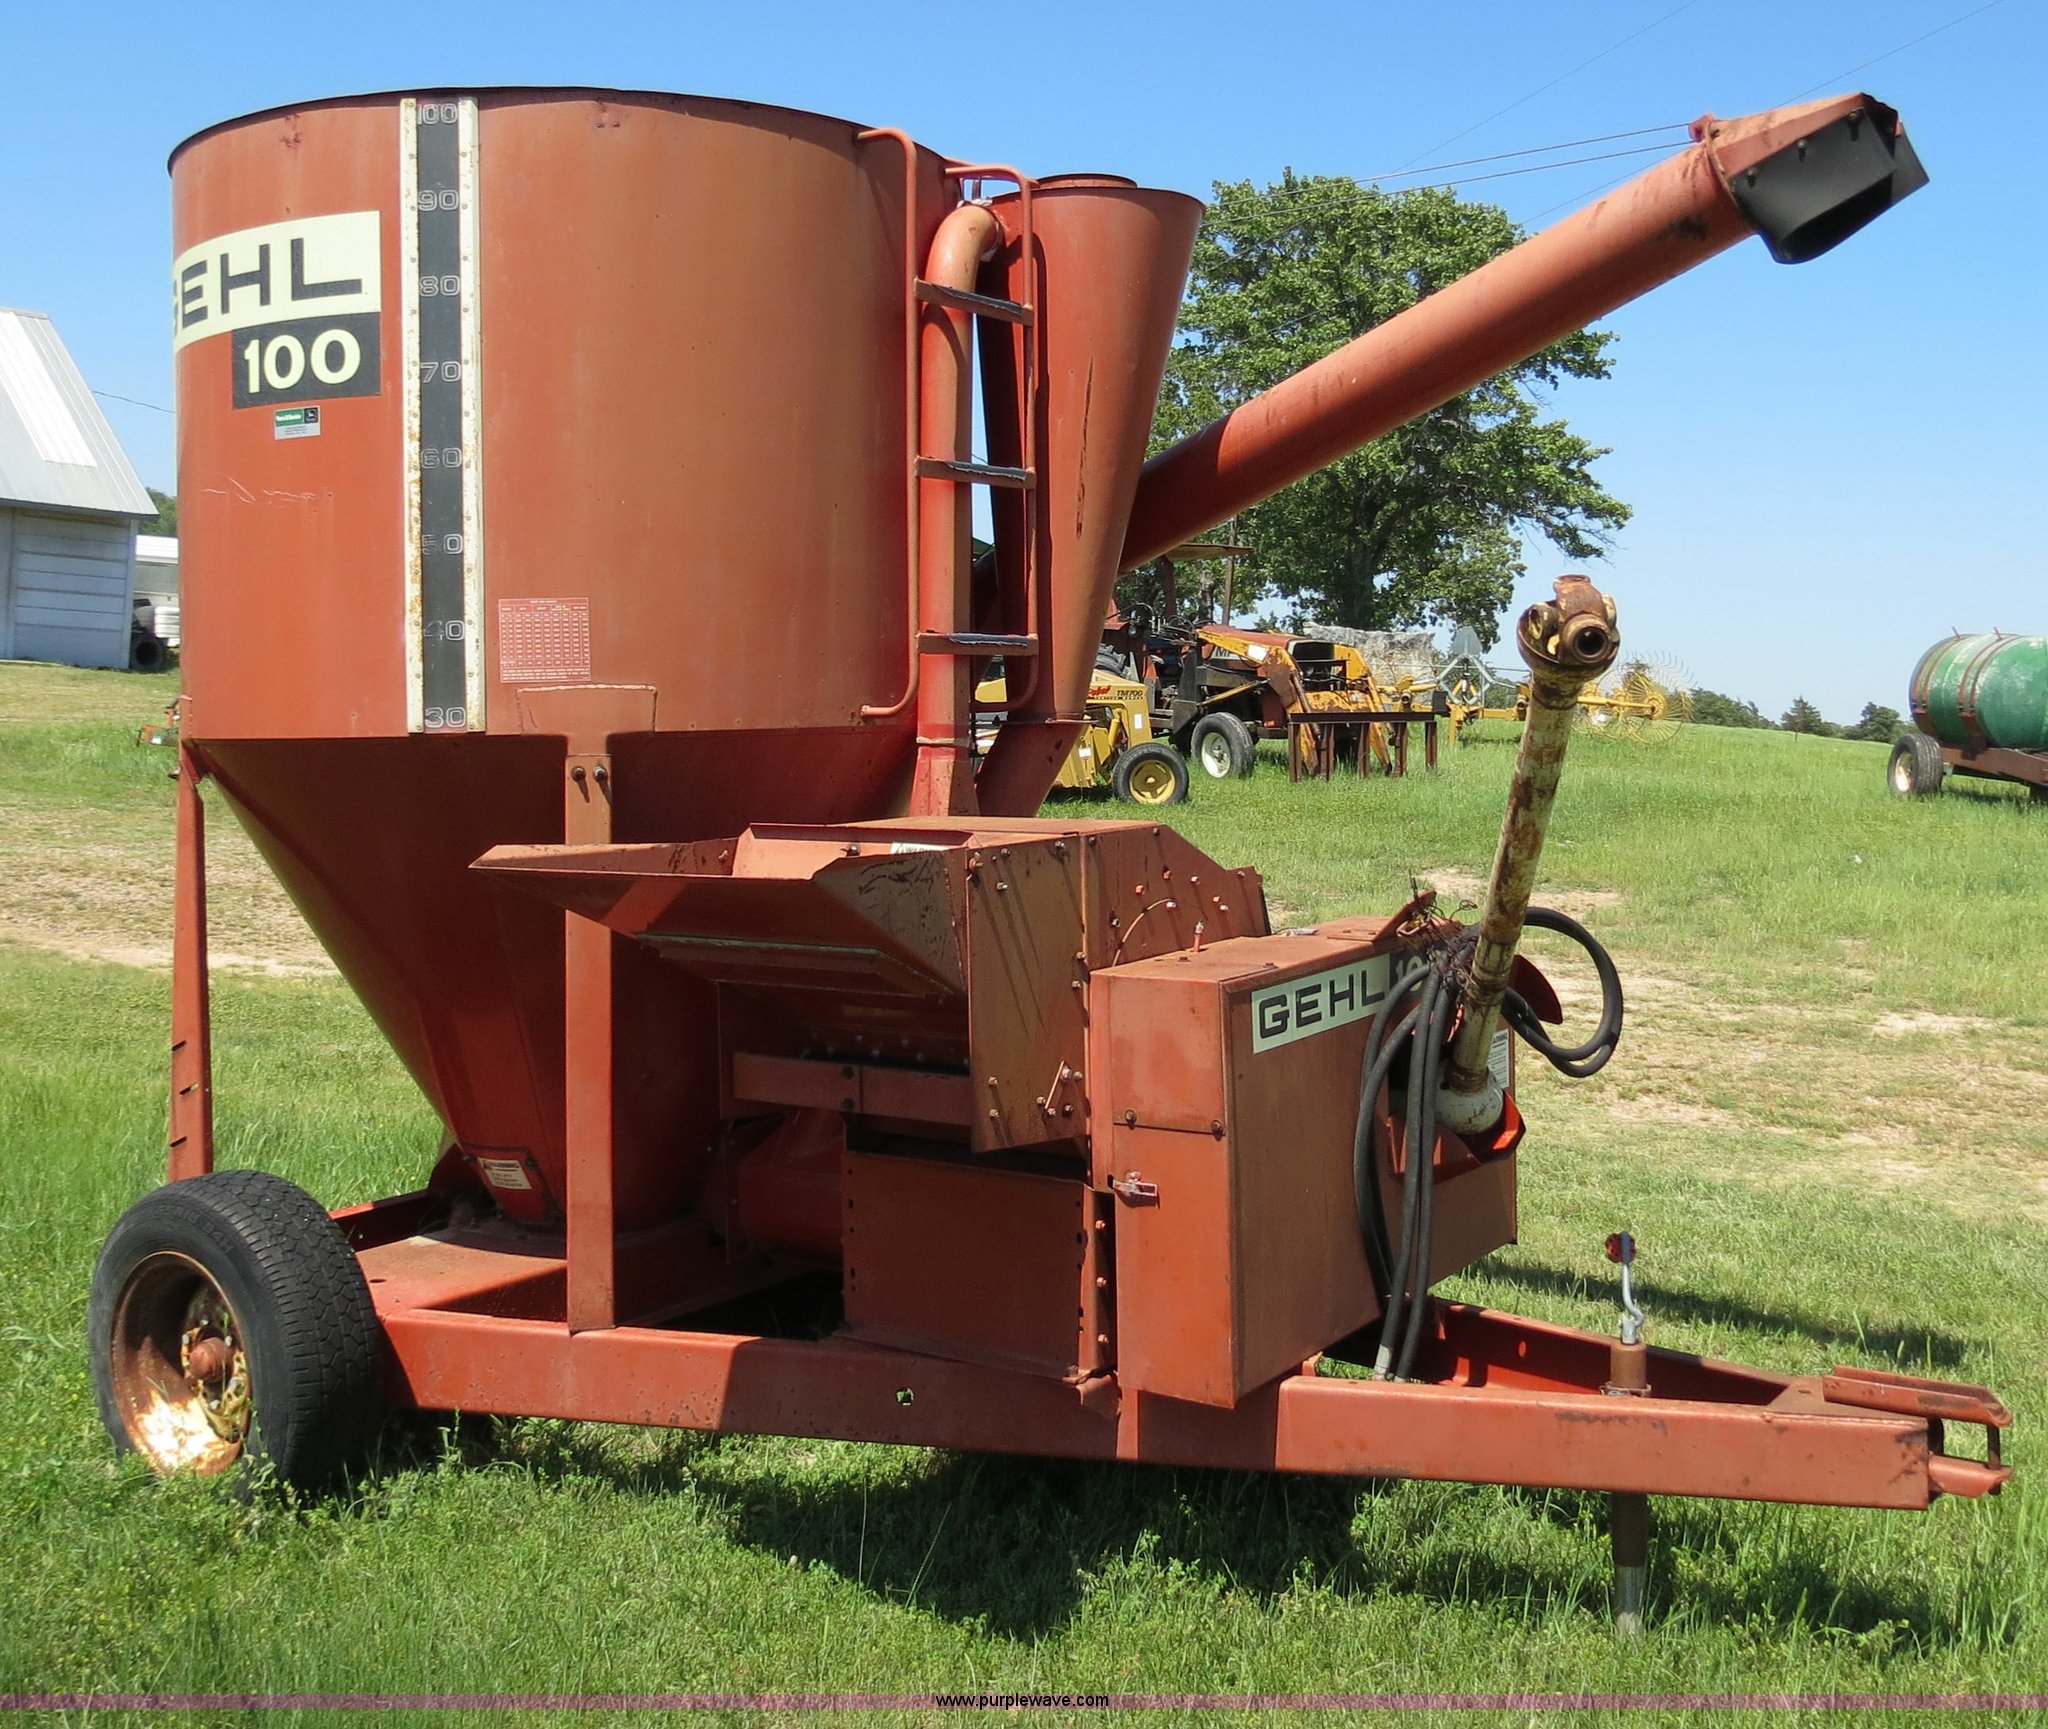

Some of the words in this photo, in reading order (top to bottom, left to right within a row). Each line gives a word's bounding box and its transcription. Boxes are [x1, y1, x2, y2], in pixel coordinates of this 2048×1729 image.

[417, 103, 458, 125] 100
[418, 190, 459, 211] 90
[174, 237, 362, 337] EHL
[420, 275, 460, 297] 80
[244, 328, 361, 394] 100
[420, 361, 461, 383] 70
[421, 448, 462, 469] 60
[425, 707, 466, 728] 30
[1259, 970, 1385, 1039] GEHL
